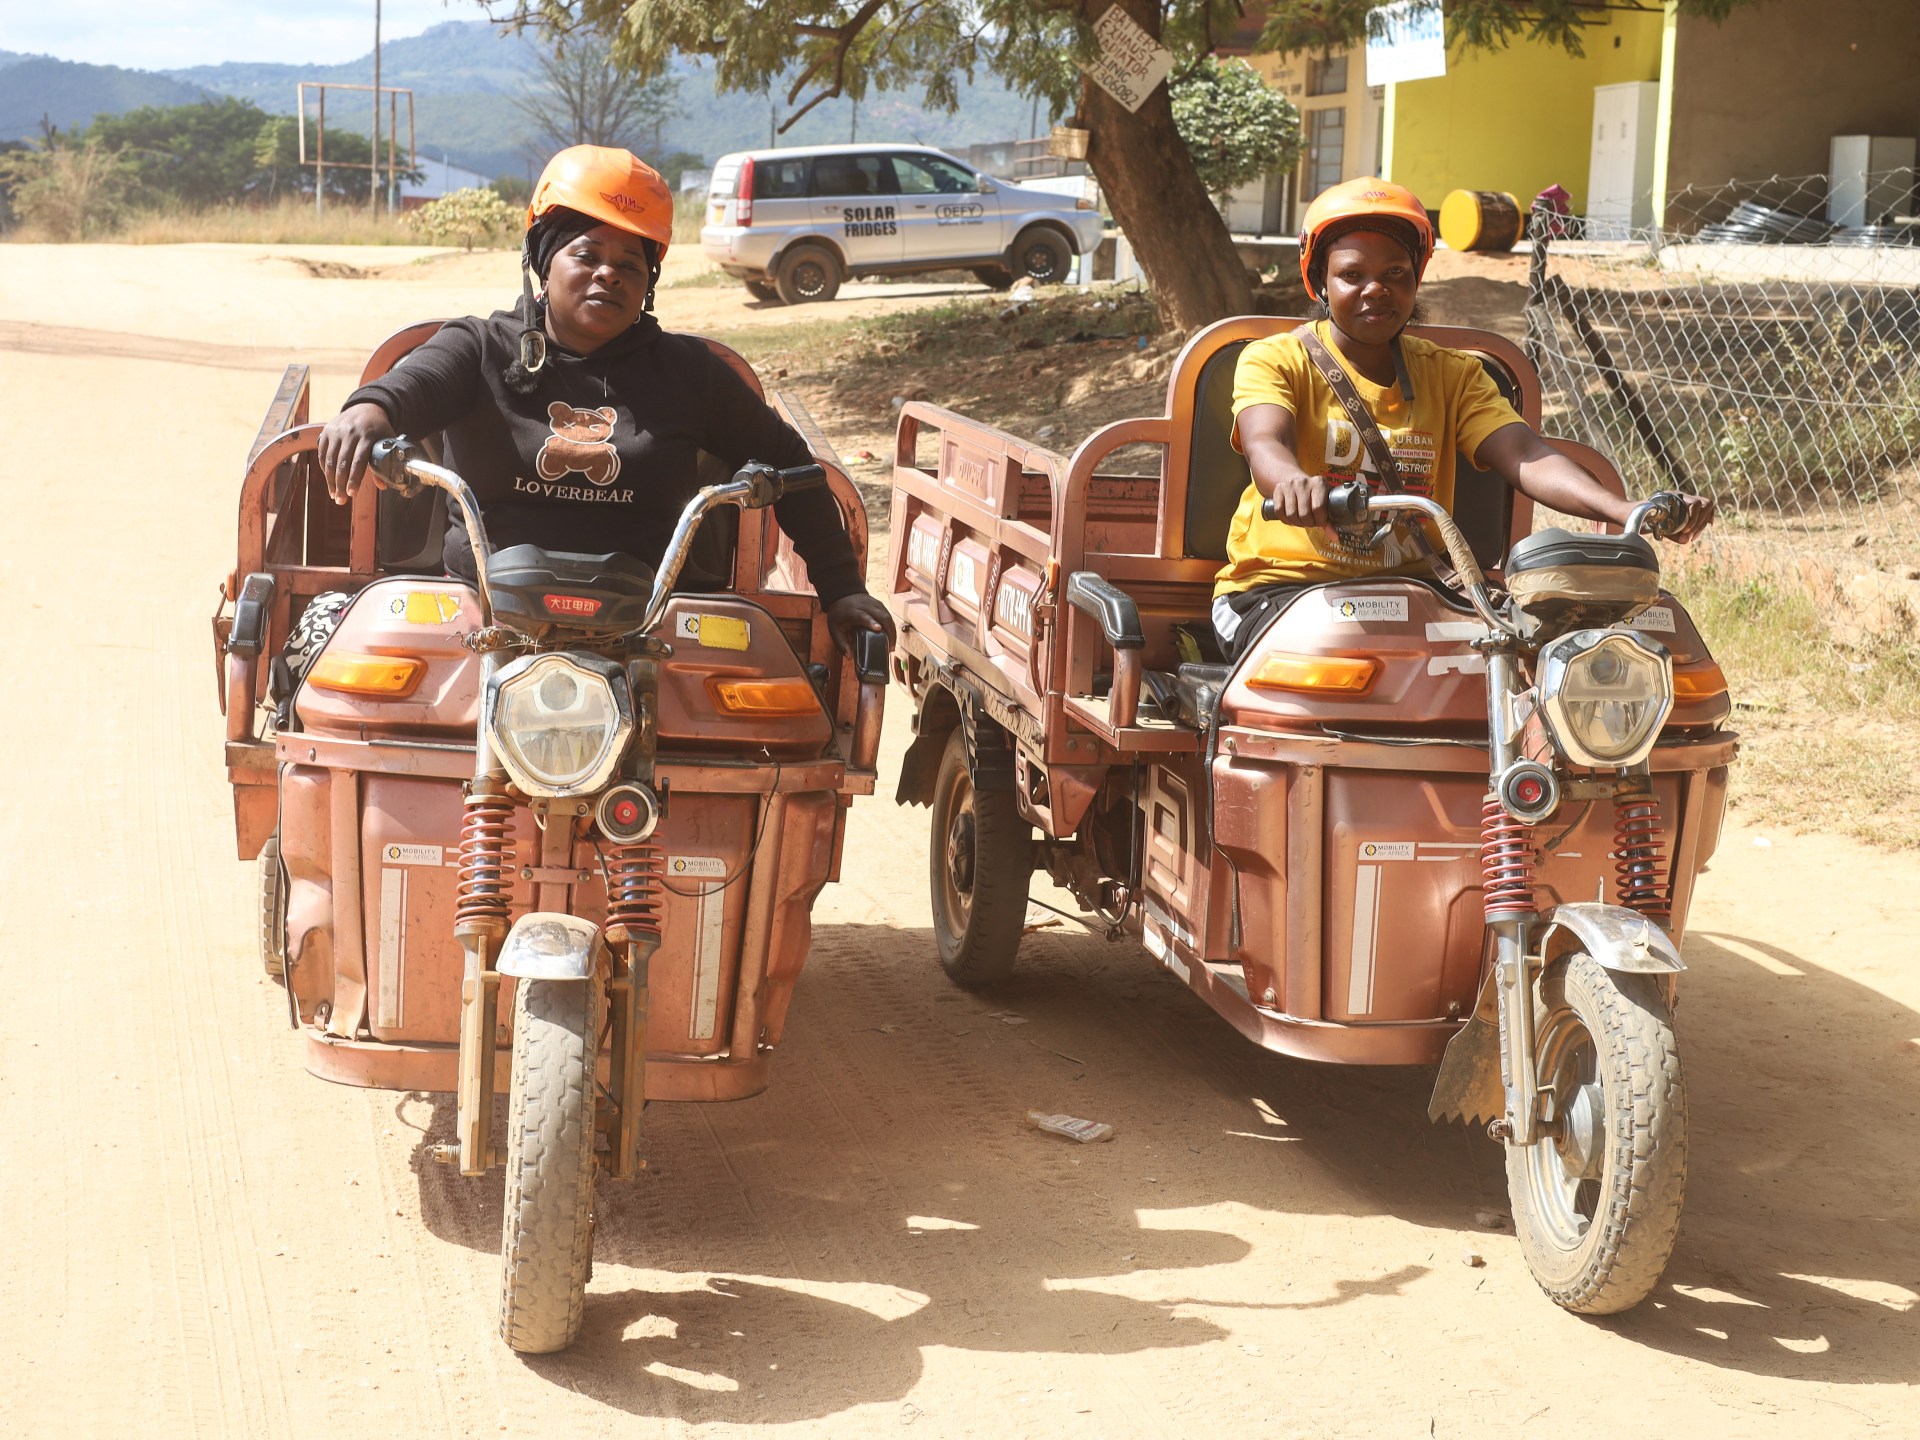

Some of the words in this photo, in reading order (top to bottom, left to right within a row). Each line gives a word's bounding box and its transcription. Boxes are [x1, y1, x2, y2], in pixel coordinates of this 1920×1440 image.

[1109, 6, 1162, 53] BATTERY
[1099, 20, 1156, 67] EXHAUST
[843, 205, 895, 222] SOLAR
[943, 205, 976, 218] DEFY
[844, 221, 897, 237] FRIDGES
[1397, 435, 1433, 446] URBAN
[1395, 461, 1433, 474] DISTRICT
[513, 477, 634, 503] LOVERBEAR
[1318, 549, 1352, 565] VINTAGE
[550, 597, 595, 613] 大江电动
[1371, 609, 1401, 617] AFRICA
[1648, 619, 1671, 627] AFRICA
